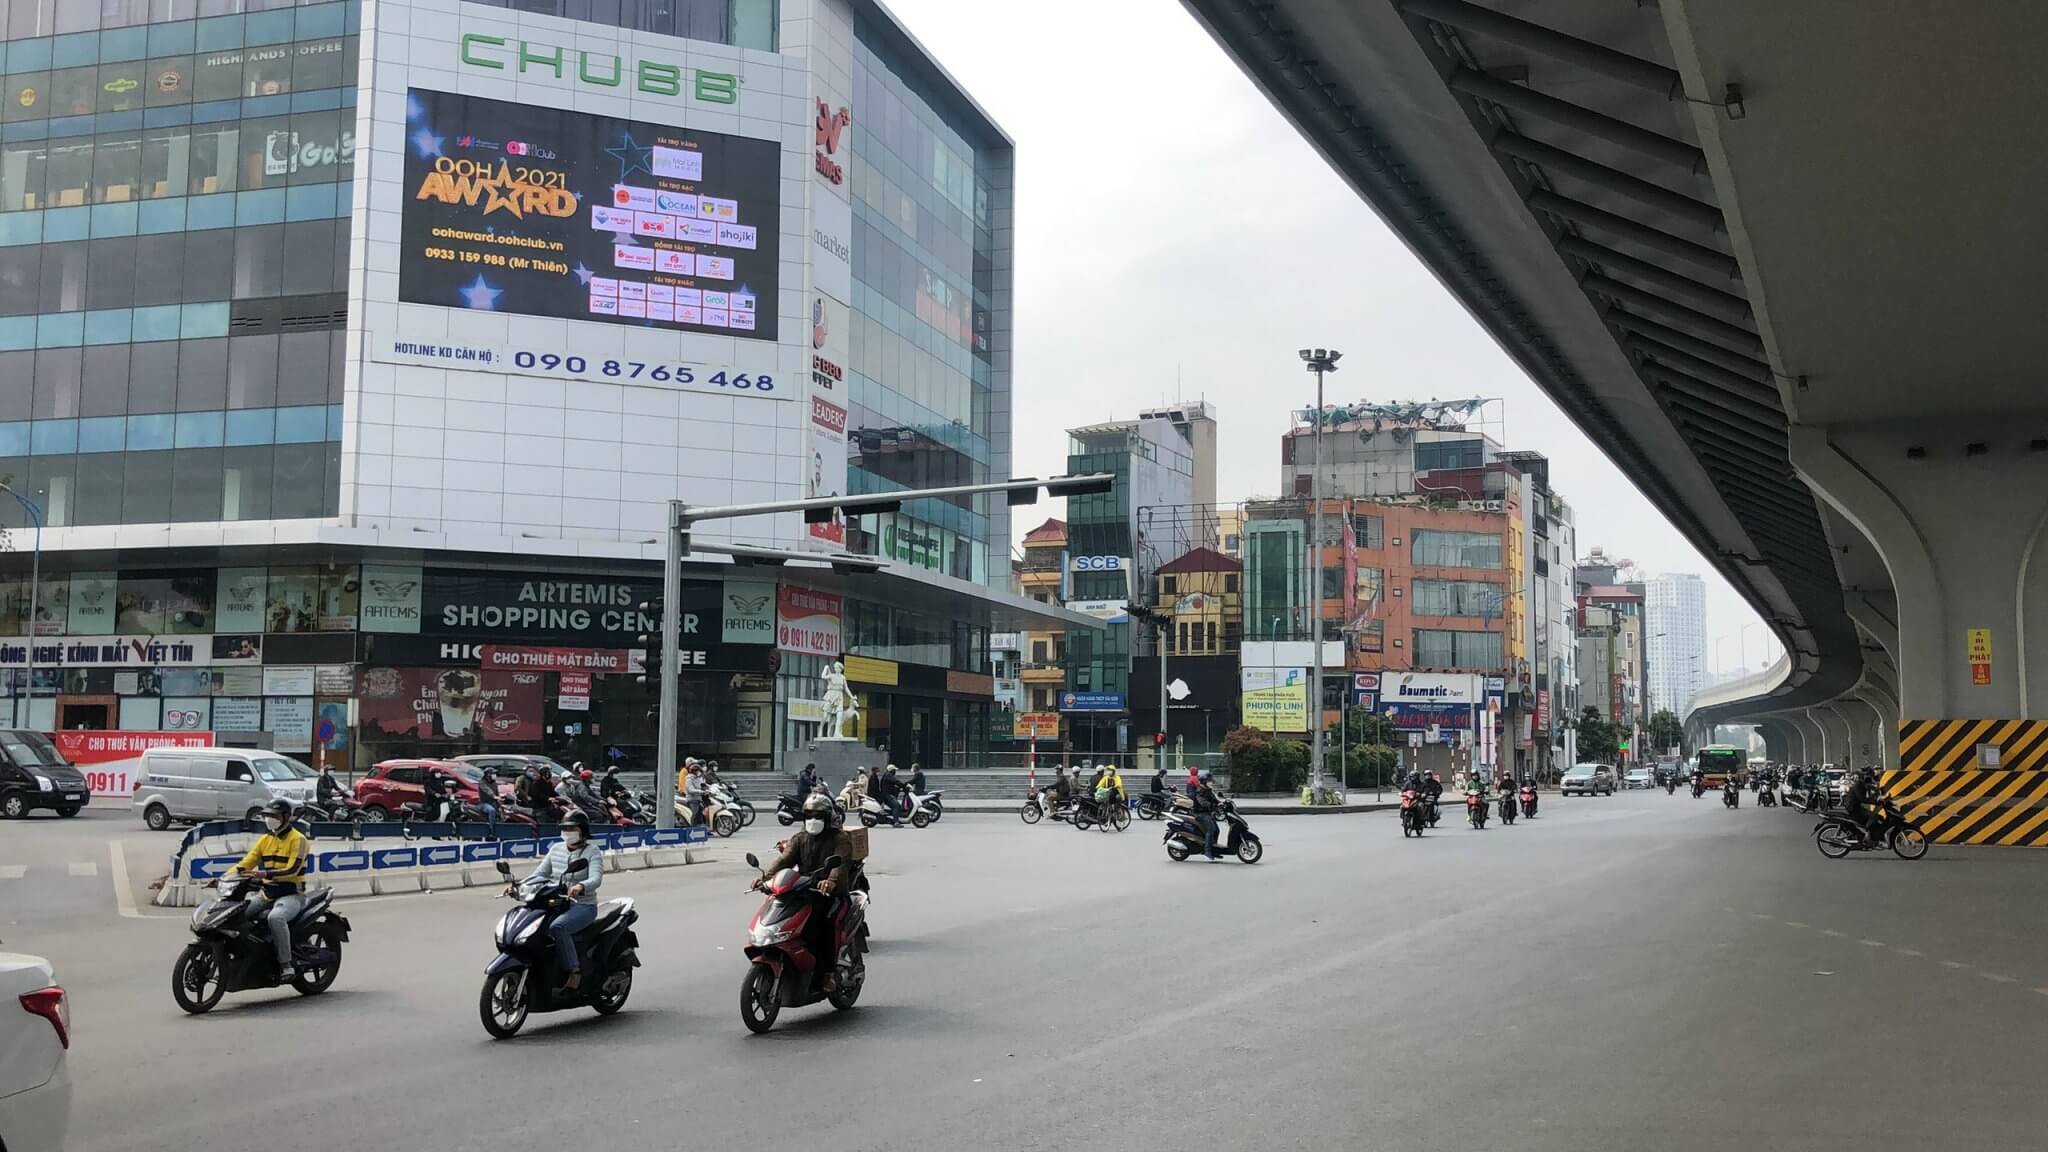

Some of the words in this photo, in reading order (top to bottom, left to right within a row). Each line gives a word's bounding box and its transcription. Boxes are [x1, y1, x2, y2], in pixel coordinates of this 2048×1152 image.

[462, 33, 737, 104] CHUBB
[435, 156, 492, 179] OOH
[515, 166, 566, 190] 2021
[432, 227, 564, 251] oohaward.oohclub.vn
[720, 230, 754, 242] shojiki
[425, 248, 455, 261] 0933
[459, 251, 481, 263] 159
[484, 254, 506, 266] 988
[508, 256, 529, 270] (Mr
[394, 342, 437, 357] HOTLINE
[439, 346, 453, 358] KD
[455, 347, 476, 360] CĂN
[479, 348, 492, 364] HỘ
[514, 351, 587, 374] 090
[602, 359, 695, 384] 8765
[708, 371, 775, 391] 468
[1076, 556, 1120, 570] SCB
[518, 581, 632, 607] ARTEMIS
[364, 605, 418, 619] ARTEMIS
[443, 605, 592, 632] SHOPPING
[725, 618, 771, 632] ARTEMIS
[67, 641, 99, 662] KÍNH
[102, 637, 129, 662] MẮT
[132, 634, 168, 665] VIỆT
[171, 640, 193, 662] TÍN
[790, 628, 808, 648] 0911
[810, 631, 824, 650] 422
[825, 633, 838, 653] 911
[493, 651, 519, 664] CHO
[523, 649, 554, 666] THUÊ
[557, 651, 583, 669] MẶT
[584, 650, 617, 667] BẰNG
[1399, 684, 1448, 697] Baumatic
[88, 738, 106, 750] CHO
[107, 736, 127, 751] THUÊ
[129, 736, 146, 751] VĂN
[86, 772, 127, 792] 0911
